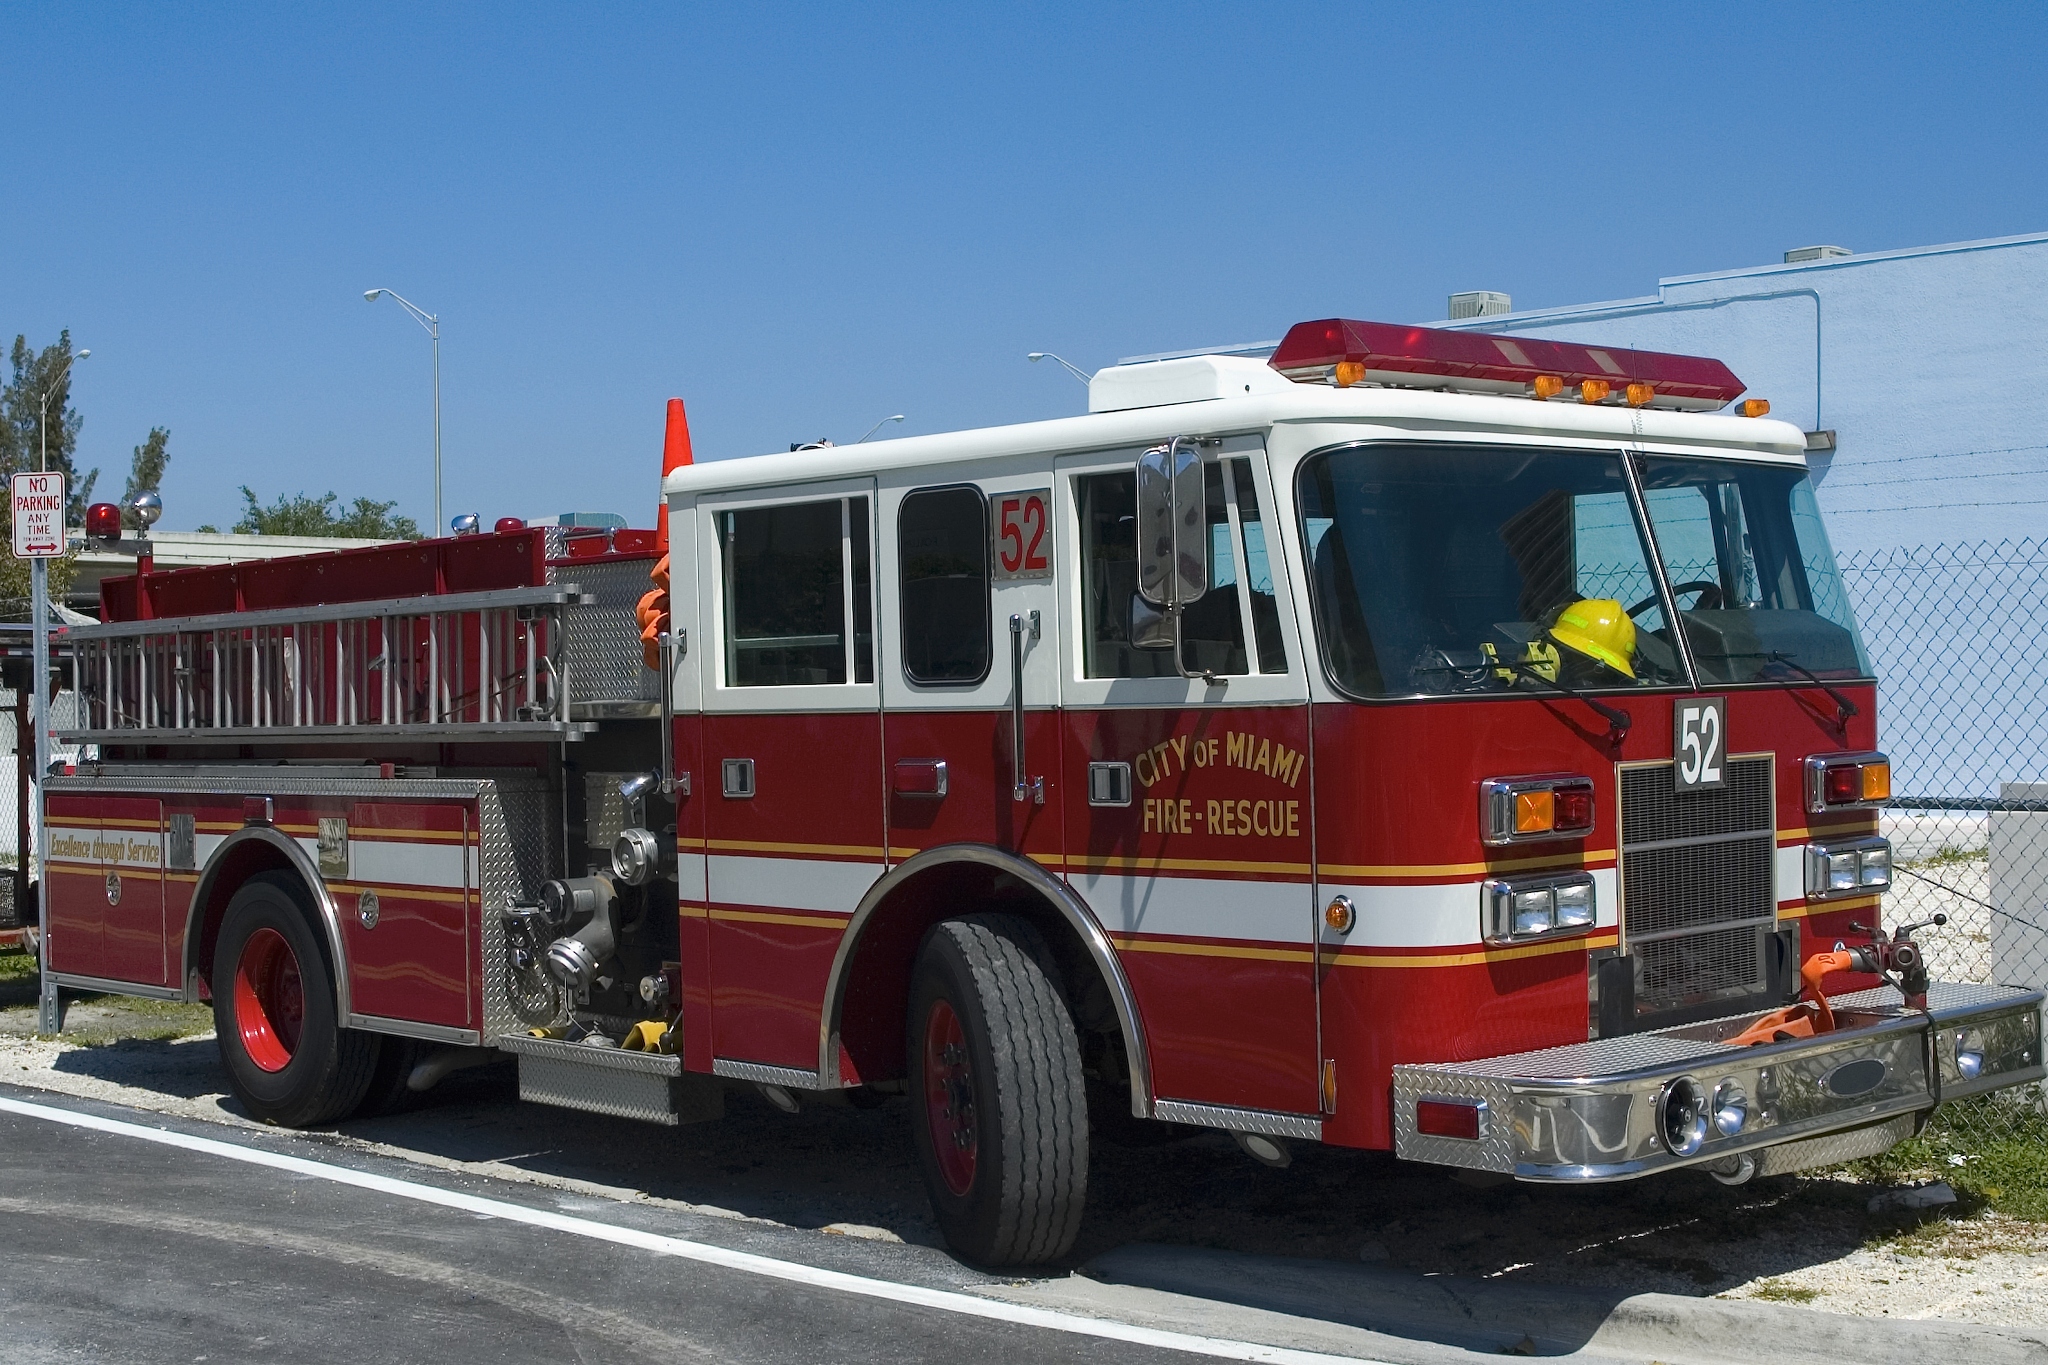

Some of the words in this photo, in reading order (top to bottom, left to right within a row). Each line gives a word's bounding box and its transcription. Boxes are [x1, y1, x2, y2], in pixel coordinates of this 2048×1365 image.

[29, 477, 48, 493] NO
[17, 495, 60, 511] PARKING
[27, 513, 50, 524] ANY
[27, 525, 51, 535] TIME
[1000, 496, 1048, 573] 52
[1680, 705, 1721, 785] 52
[1135, 734, 1187, 788] CITY
[1193, 738, 1219, 768] OF
[1226, 730, 1305, 789] MIAMI
[50, 833, 91, 859] Excellence
[92, 836, 125, 864] through
[127, 837, 160, 863] Service
